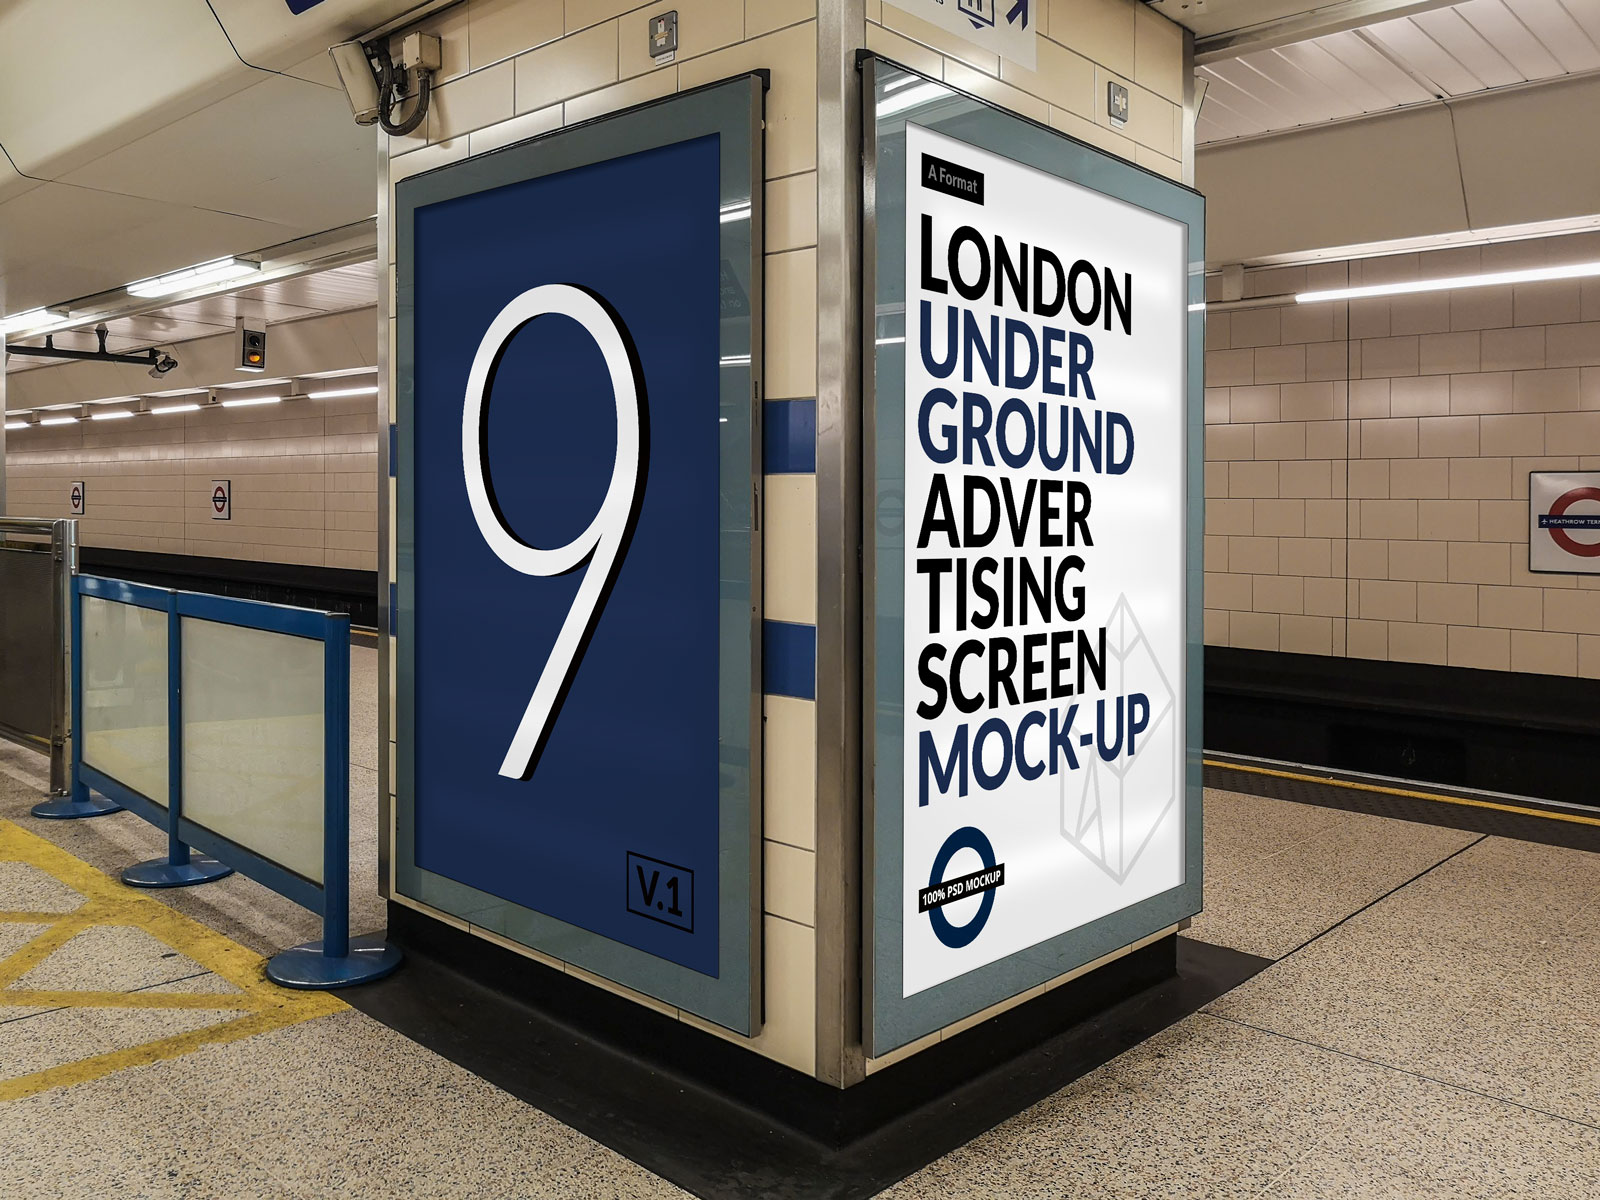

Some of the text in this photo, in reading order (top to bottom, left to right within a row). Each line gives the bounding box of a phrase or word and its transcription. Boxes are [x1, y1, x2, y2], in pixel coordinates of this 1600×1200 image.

[928, 164, 978, 194] A Format
[921, 213, 1132, 336] LONDON
[920, 299, 1096, 400] UNDER
[918, 388, 1135, 475] GROUND
[462, 283, 649, 782] 9
[917, 473, 1095, 548] ADVER
[916, 555, 1086, 634] TISING
[916, 627, 1107, 721] SCREEN
[918, 692, 1150, 808] MOCK-UP
[636, 864, 683, 917] V.1
[922, 870, 1001, 905] 100% PSD MOCKUP
